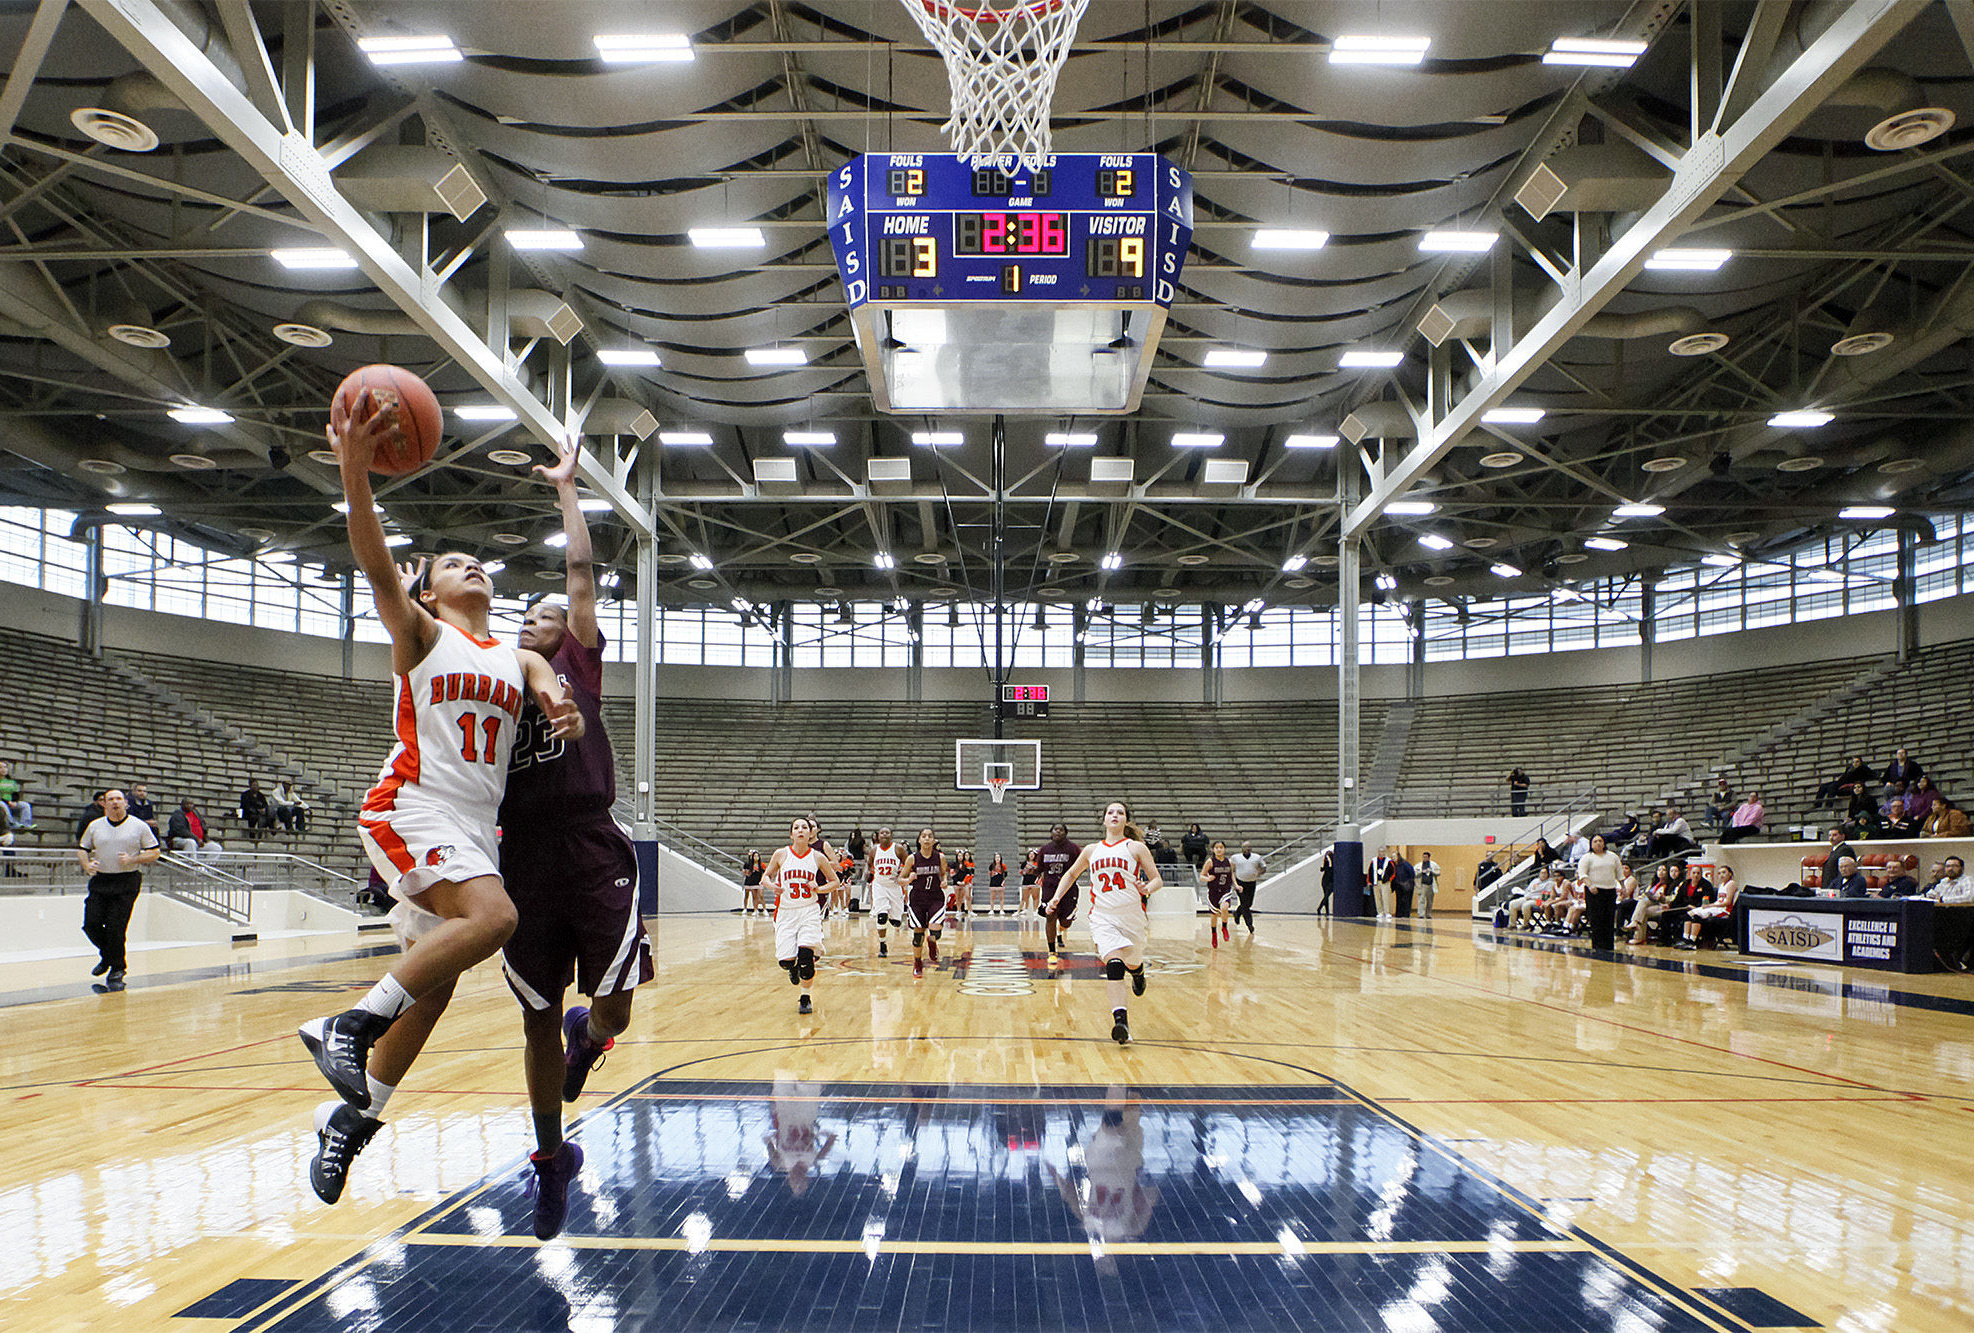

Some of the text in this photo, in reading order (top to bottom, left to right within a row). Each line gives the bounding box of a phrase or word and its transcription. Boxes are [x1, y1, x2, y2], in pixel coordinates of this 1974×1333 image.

[890, 155, 923, 167] FOULS
[970, 156, 1057, 167] PLAER FOLS
[1100, 156, 1133, 167] FOULS
[907, 170, 923, 195] 2
[1116, 170, 1133, 195] 2
[896, 198, 916, 207] WON
[1008, 197, 1033, 207] GAME
[1104, 198, 1125, 207] WON
[883, 216, 930, 234] HOME
[983, 213, 1065, 252] 2:36
[1089, 216, 1147, 235] VISITOR
[913, 237, 936, 277] 3
[1121, 237, 1144, 278] 9
[1029, 275, 1058, 285] PERIOD
[1014, 686, 1047, 700] 2:36
[456, 711, 502, 765] 11
[878, 866, 893, 876] 22
[1098, 872, 1126, 893] 24
[790, 883, 812, 899] 33
[1848, 920, 1888, 934] EXCELLENCE
[1766, 930, 1821, 948] SAISD
[1847, 932, 1881, 946] ATHLETICS
[1881, 935, 1897, 947] AND
[1852, 945, 1891, 960] ACADEMICS
